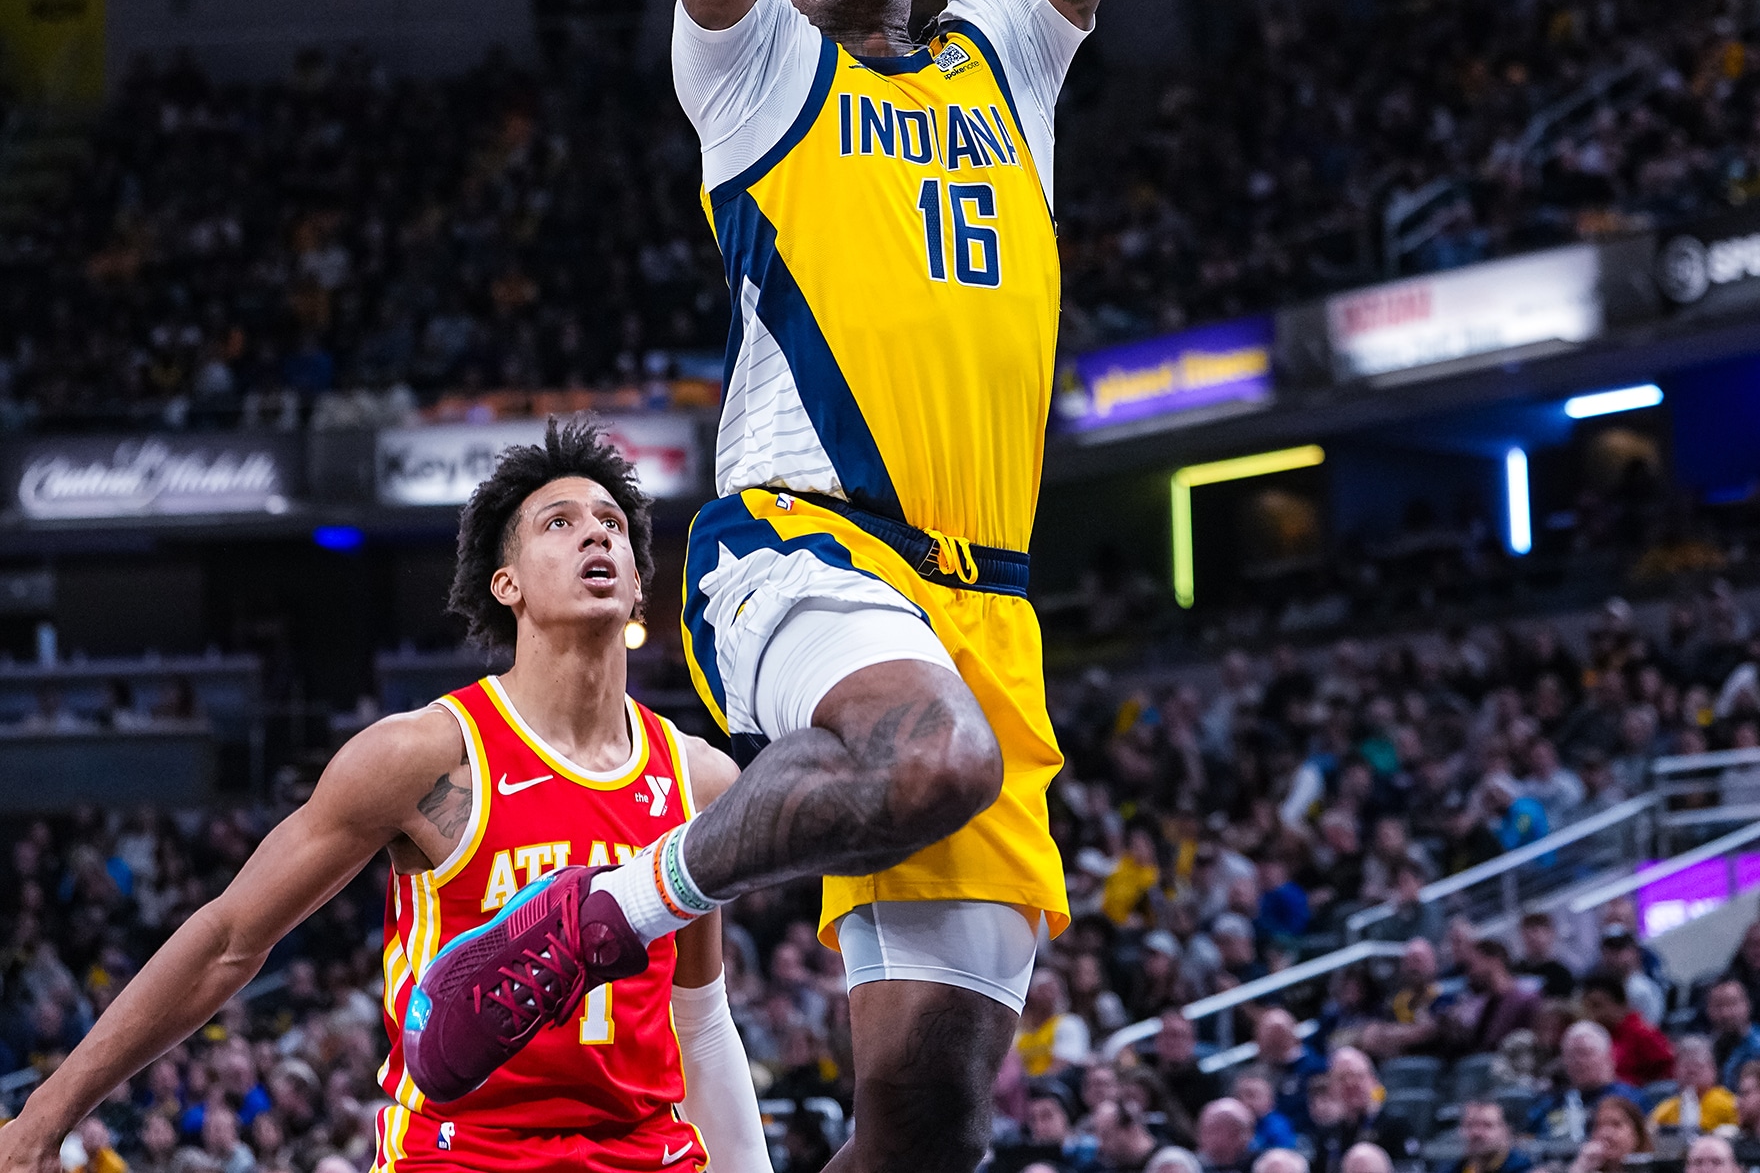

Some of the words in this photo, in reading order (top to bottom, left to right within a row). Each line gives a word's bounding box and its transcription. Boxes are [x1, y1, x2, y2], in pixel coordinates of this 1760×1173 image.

[838, 92, 1023, 171] INDIANA
[916, 177, 1002, 289] 16
[634, 791, 649, 804] the
